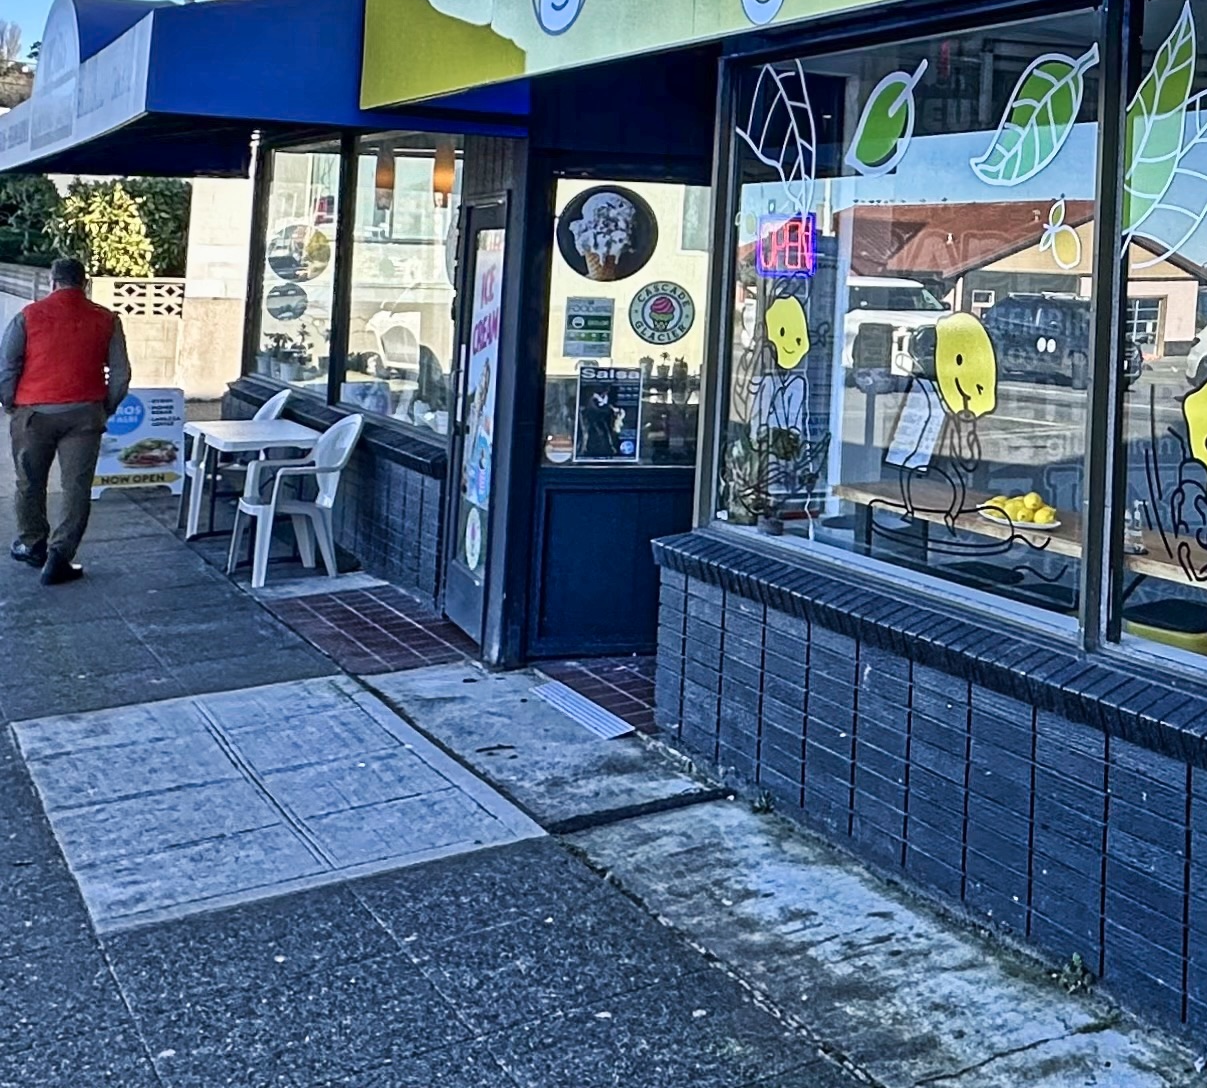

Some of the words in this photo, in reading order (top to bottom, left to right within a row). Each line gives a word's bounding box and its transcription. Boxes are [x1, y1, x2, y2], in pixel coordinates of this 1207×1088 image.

[637, 283, 691, 308] CASCADE
[634, 320, 688, 342] GLACIER
[581, 368, 640, 380] Salsa
[101, 475, 128, 485] NOW
[132, 473, 165, 483] OPEN
